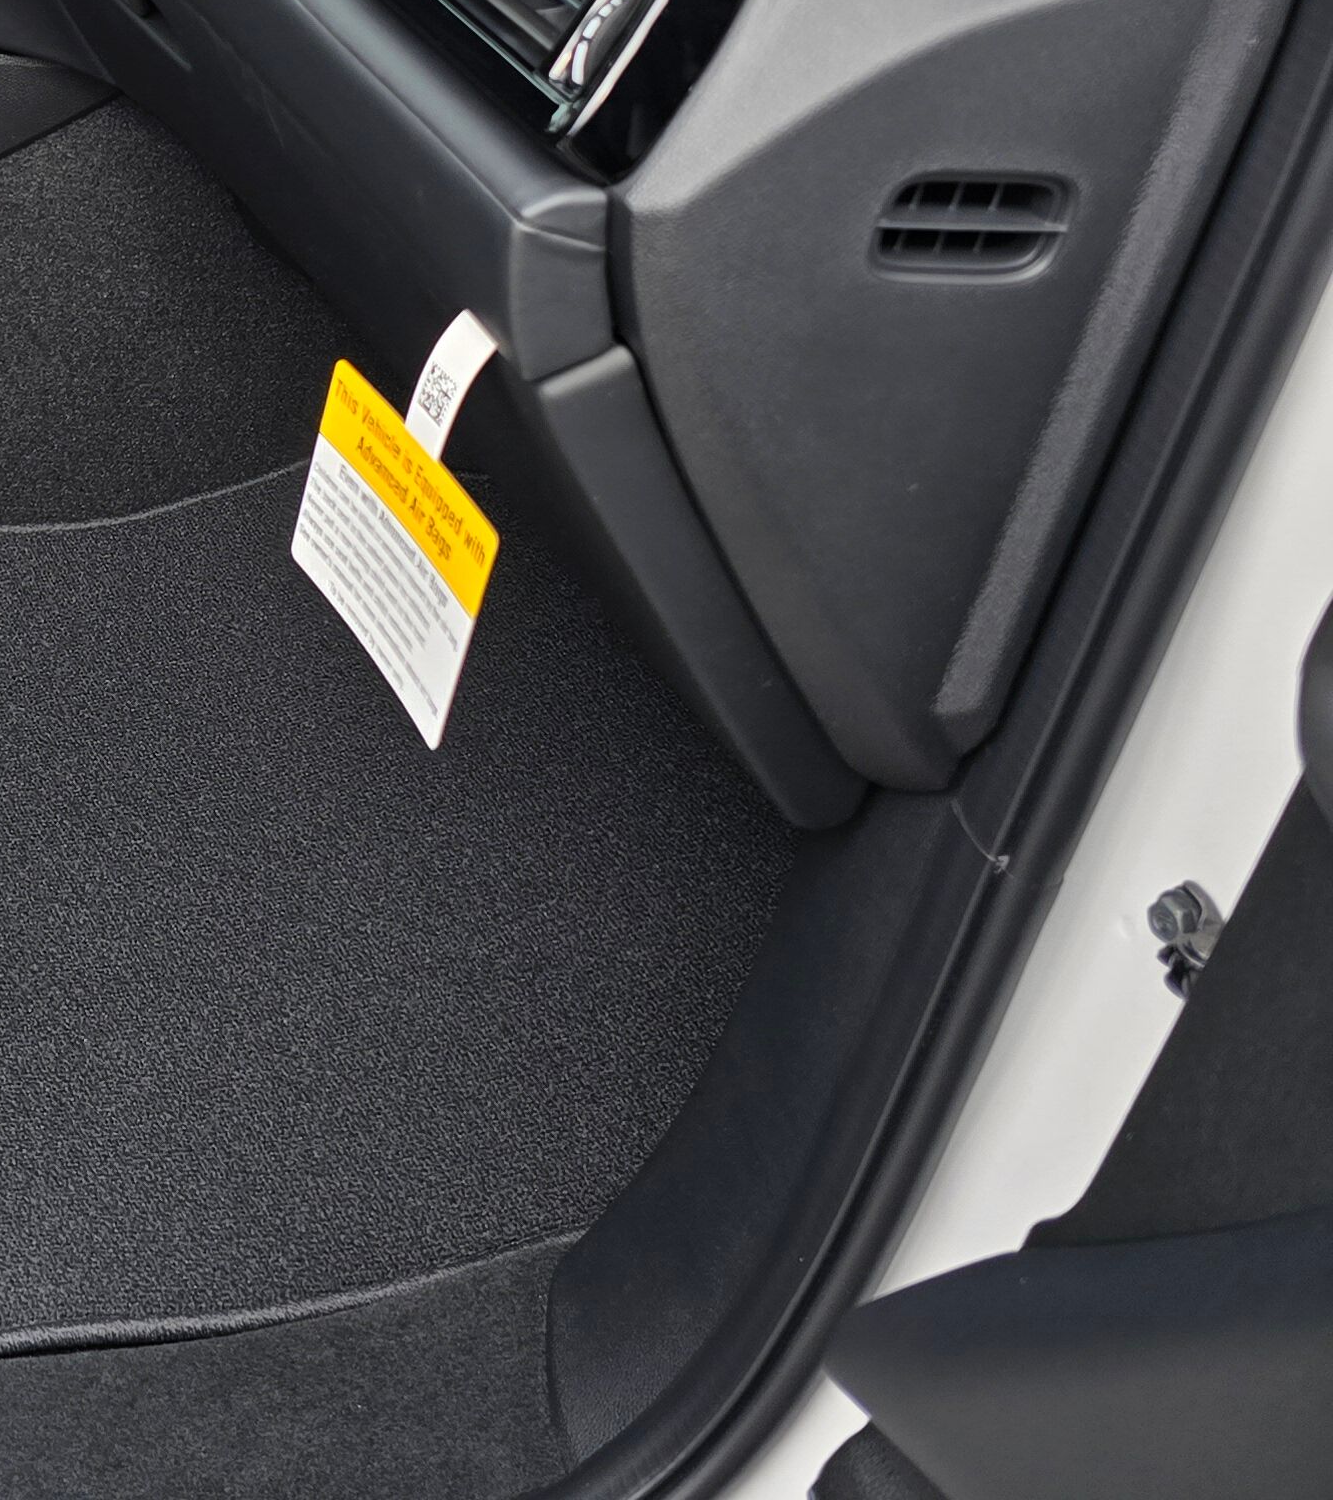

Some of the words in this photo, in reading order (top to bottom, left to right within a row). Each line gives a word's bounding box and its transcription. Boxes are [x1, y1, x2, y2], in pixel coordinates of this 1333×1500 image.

[335, 380, 358, 416] This
[362, 404, 401, 461] Vehicle
[414, 465, 463, 534] Equipped
[463, 528, 487, 567] with
[355, 436, 409, 504] Advanced
[408, 497, 427, 524] Air
[426, 516, 453, 562] Bags
